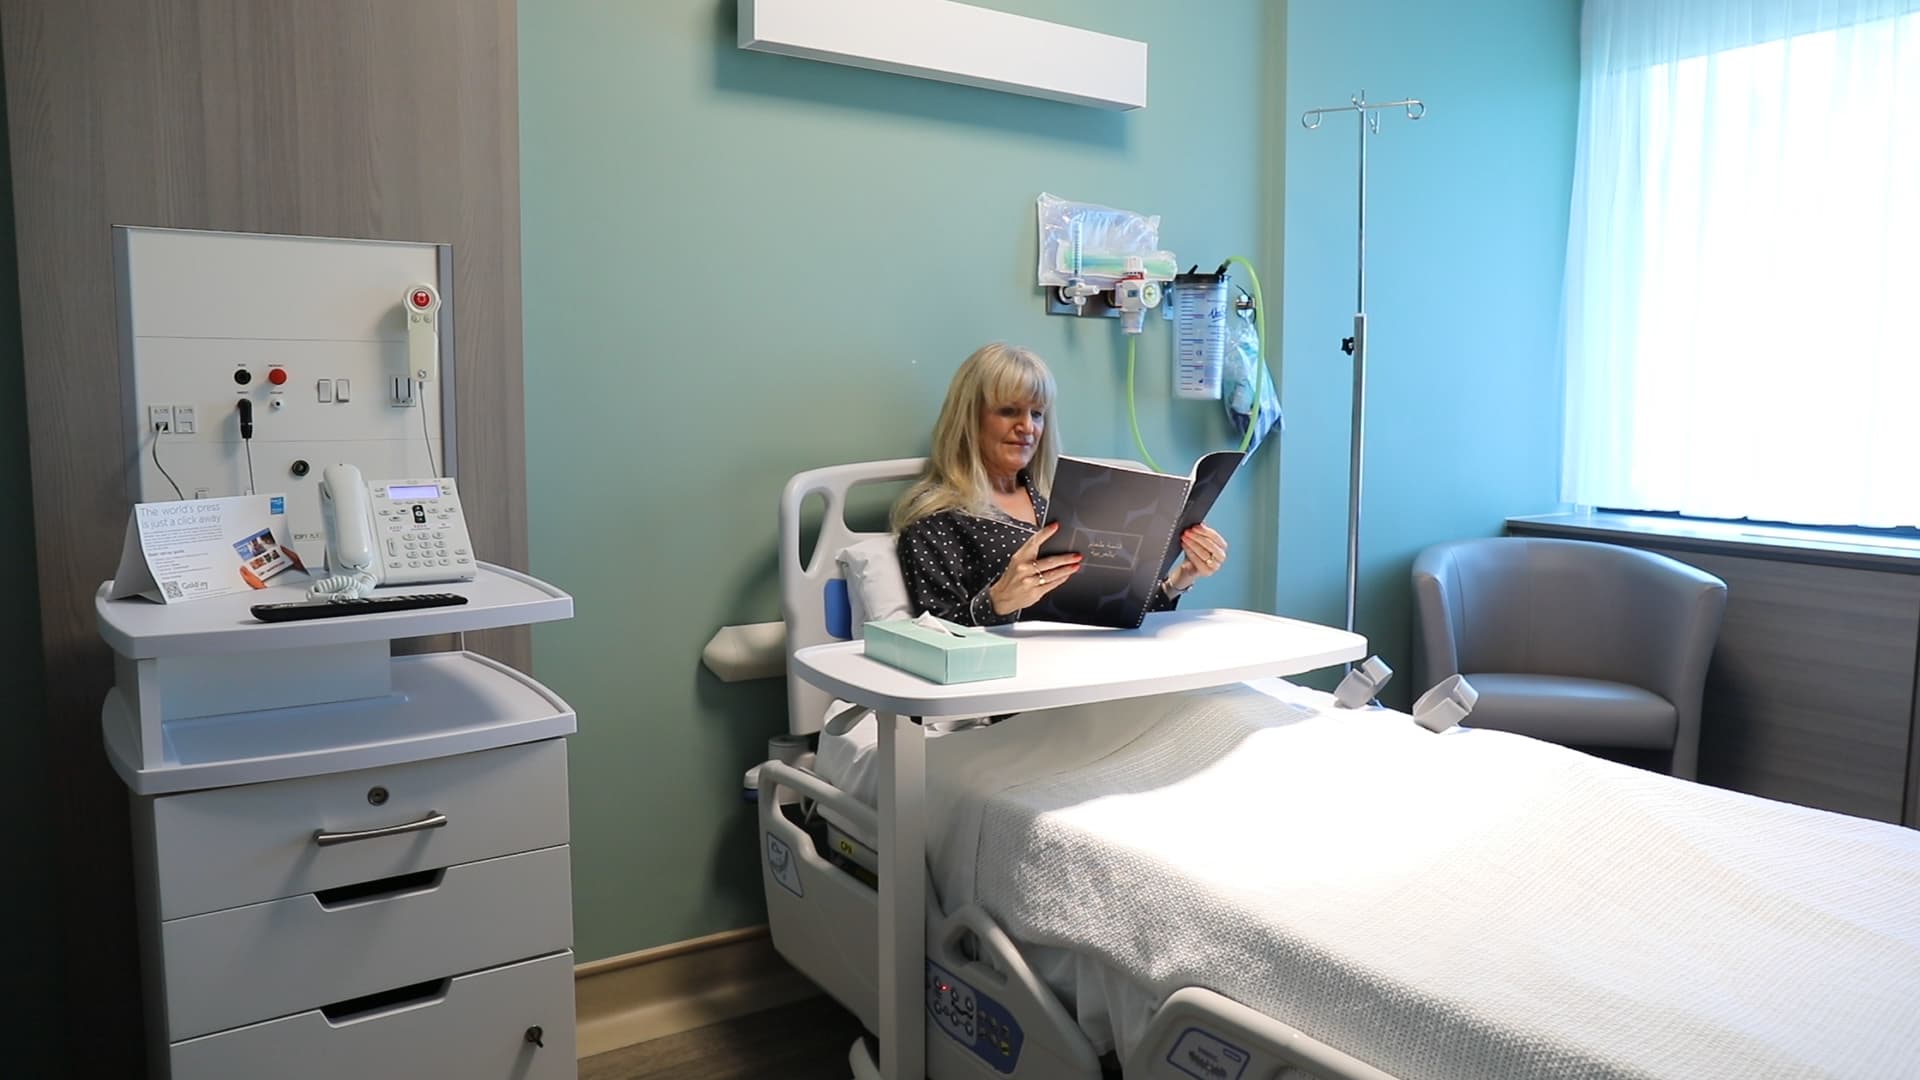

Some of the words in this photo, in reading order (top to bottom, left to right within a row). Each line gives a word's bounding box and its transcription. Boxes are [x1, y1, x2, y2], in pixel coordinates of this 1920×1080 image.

[141, 507, 159, 517] The
[161, 504, 194, 516] world's
[197, 503, 221, 515] press
[150, 518, 169, 531] just
[177, 515, 197, 526] click
[198, 514, 222, 525] away
